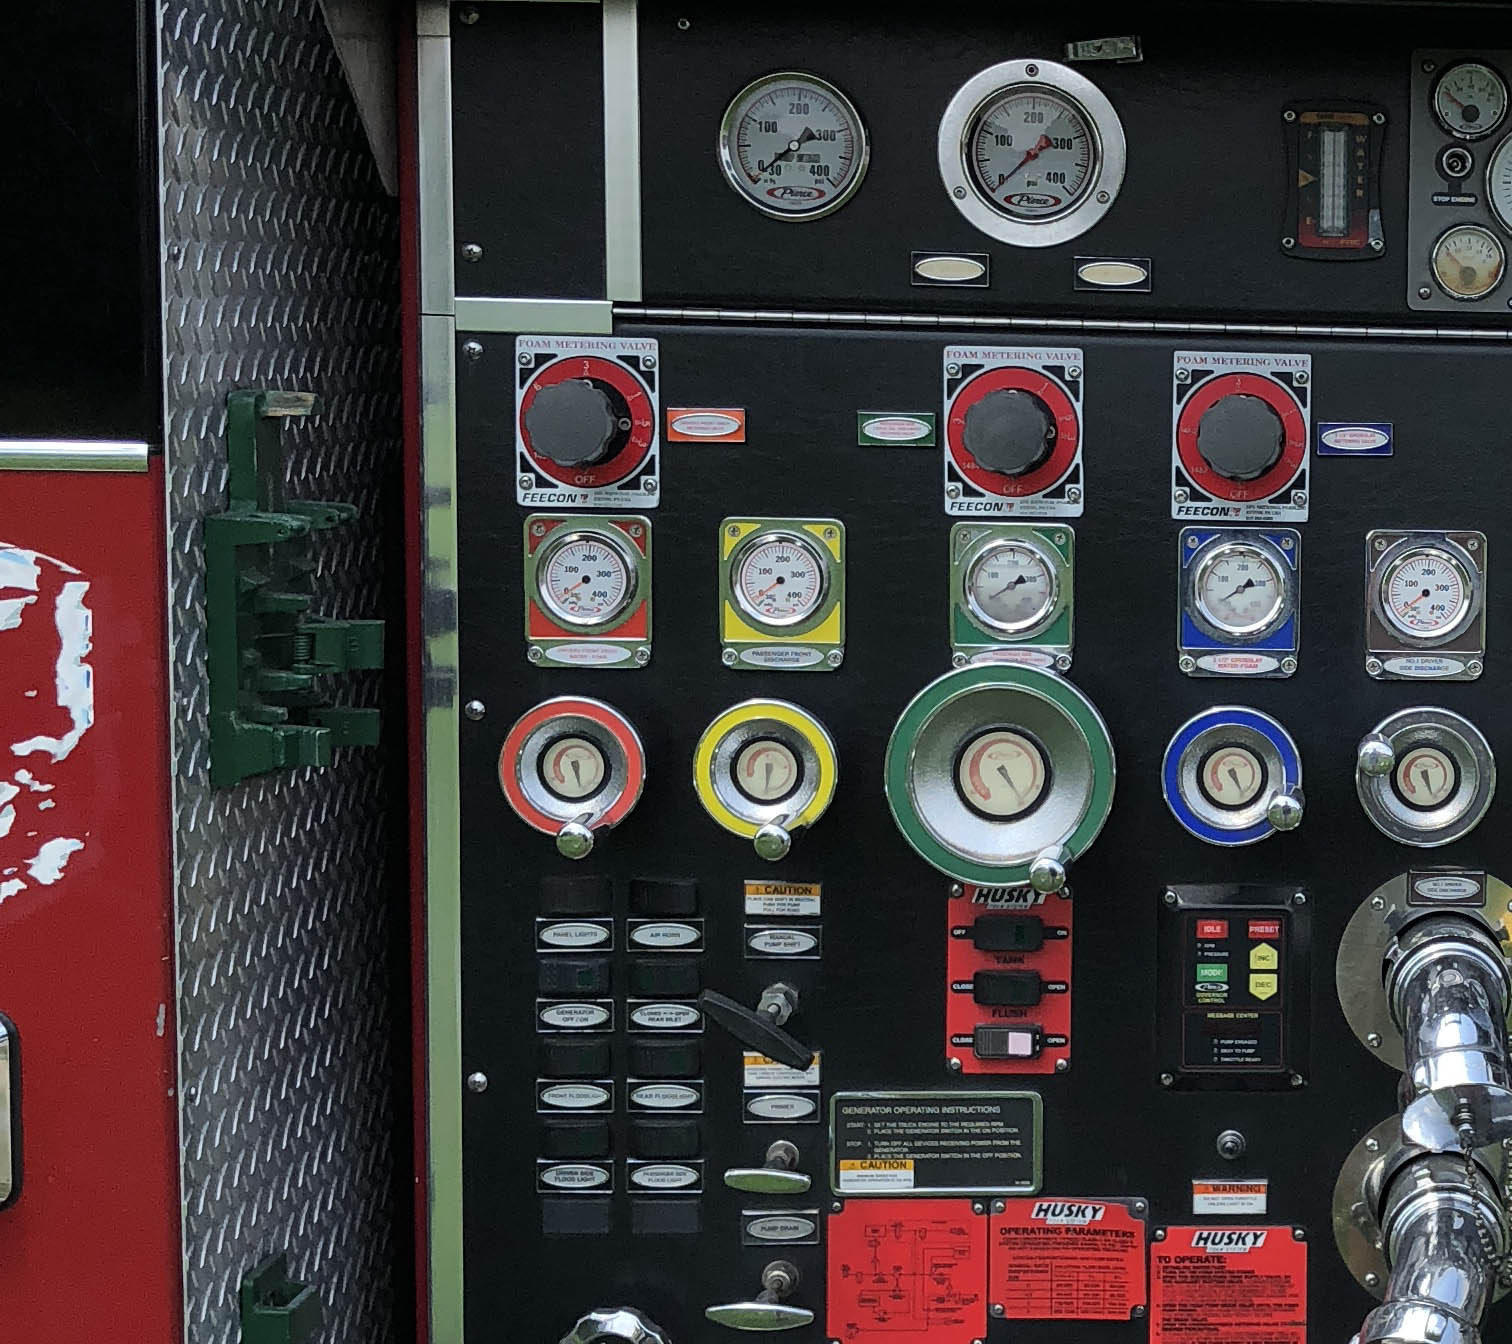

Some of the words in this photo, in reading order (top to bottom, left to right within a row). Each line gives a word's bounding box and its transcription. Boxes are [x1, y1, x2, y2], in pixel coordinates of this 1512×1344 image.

[788, 103, 809, 115] 200
[1024, 112, 1043, 124] 200
[758, 121, 777, 133] 100
[816, 129, 836, 142] 300
[994, 134, 1012, 146] 100
[1053, 138, 1072, 150] 300
[809, 164, 829, 177] 400
[1356, 135, 1367, 198] WATER
[1046, 172, 1065, 185] 400
[781, 187, 814, 199] Pierce
[1017, 194, 1050, 207] Pierce
[519, 339, 550, 348] FOAM
[555, 340, 616, 350] METERING
[620, 341, 656, 351] VALVE
[946, 350, 978, 359] FOAM
[983, 351, 1042, 360] METERING
[1047, 352, 1081, 361] VALVE
[1176, 356, 1208, 365] FOAM
[1212, 357, 1271, 366] METERING
[1274, 359, 1308, 368] VALVE
[575, 475, 595, 484] OFF
[1003, 485, 1023, 493] OFF
[523, 493, 577, 503] FEECON
[950, 502, 1003, 512] FEECON
[1177, 506, 1229, 516] FEECON
[765, 885, 812, 895] CAUTION
[975, 888, 1046, 903] HUSKY
[994, 956, 1024, 964] TANK
[842, 1106, 892, 1114] GENERATOR
[860, 1161, 907, 1169] CAUTION
[1212, 1185, 1261, 1193] WARNING
[1035, 1204, 1102, 1218] HUSKY
[1065, 1228, 1135, 1238] PARAMETERS
[1195, 1232, 1266, 1246] HUSKY
[1156, 1256, 1172, 1264] TO
[1175, 1256, 1227, 1264] OPERATE:
